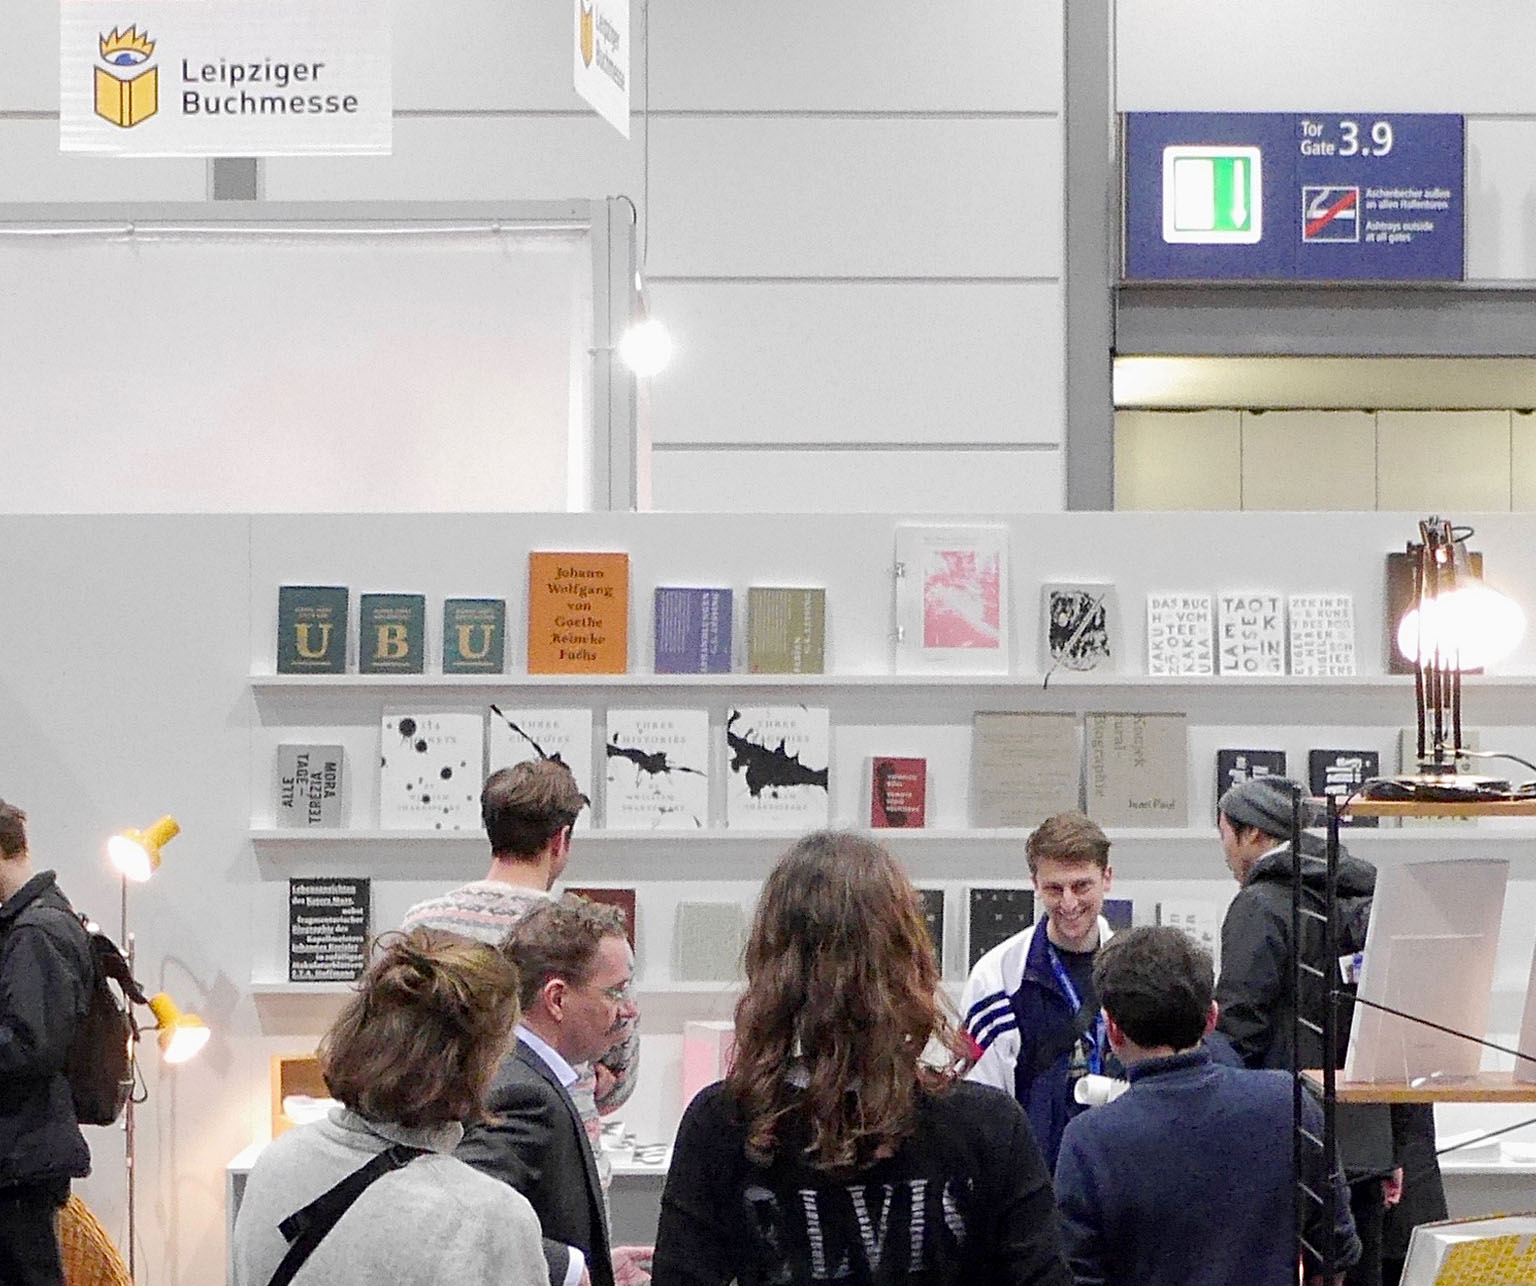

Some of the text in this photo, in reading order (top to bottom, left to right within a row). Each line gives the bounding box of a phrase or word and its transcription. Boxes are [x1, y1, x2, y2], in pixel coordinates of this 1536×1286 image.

[182, 58, 325, 86] Leipziger
[182, 91, 359, 115] Buchmesse
[1301, 120, 1393, 156] Tor 3.9
[1300, 140, 1335, 156] Gate
[555, 567, 604, 581] Johann
[546, 583, 614, 598] Wolfgang
[567, 601, 592, 612] von
[554, 616, 603, 628] Goethe
[294, 623, 495, 659] U B U
[559, 649, 597, 661] Fuchs
[282, 776, 295, 808] ALLE
